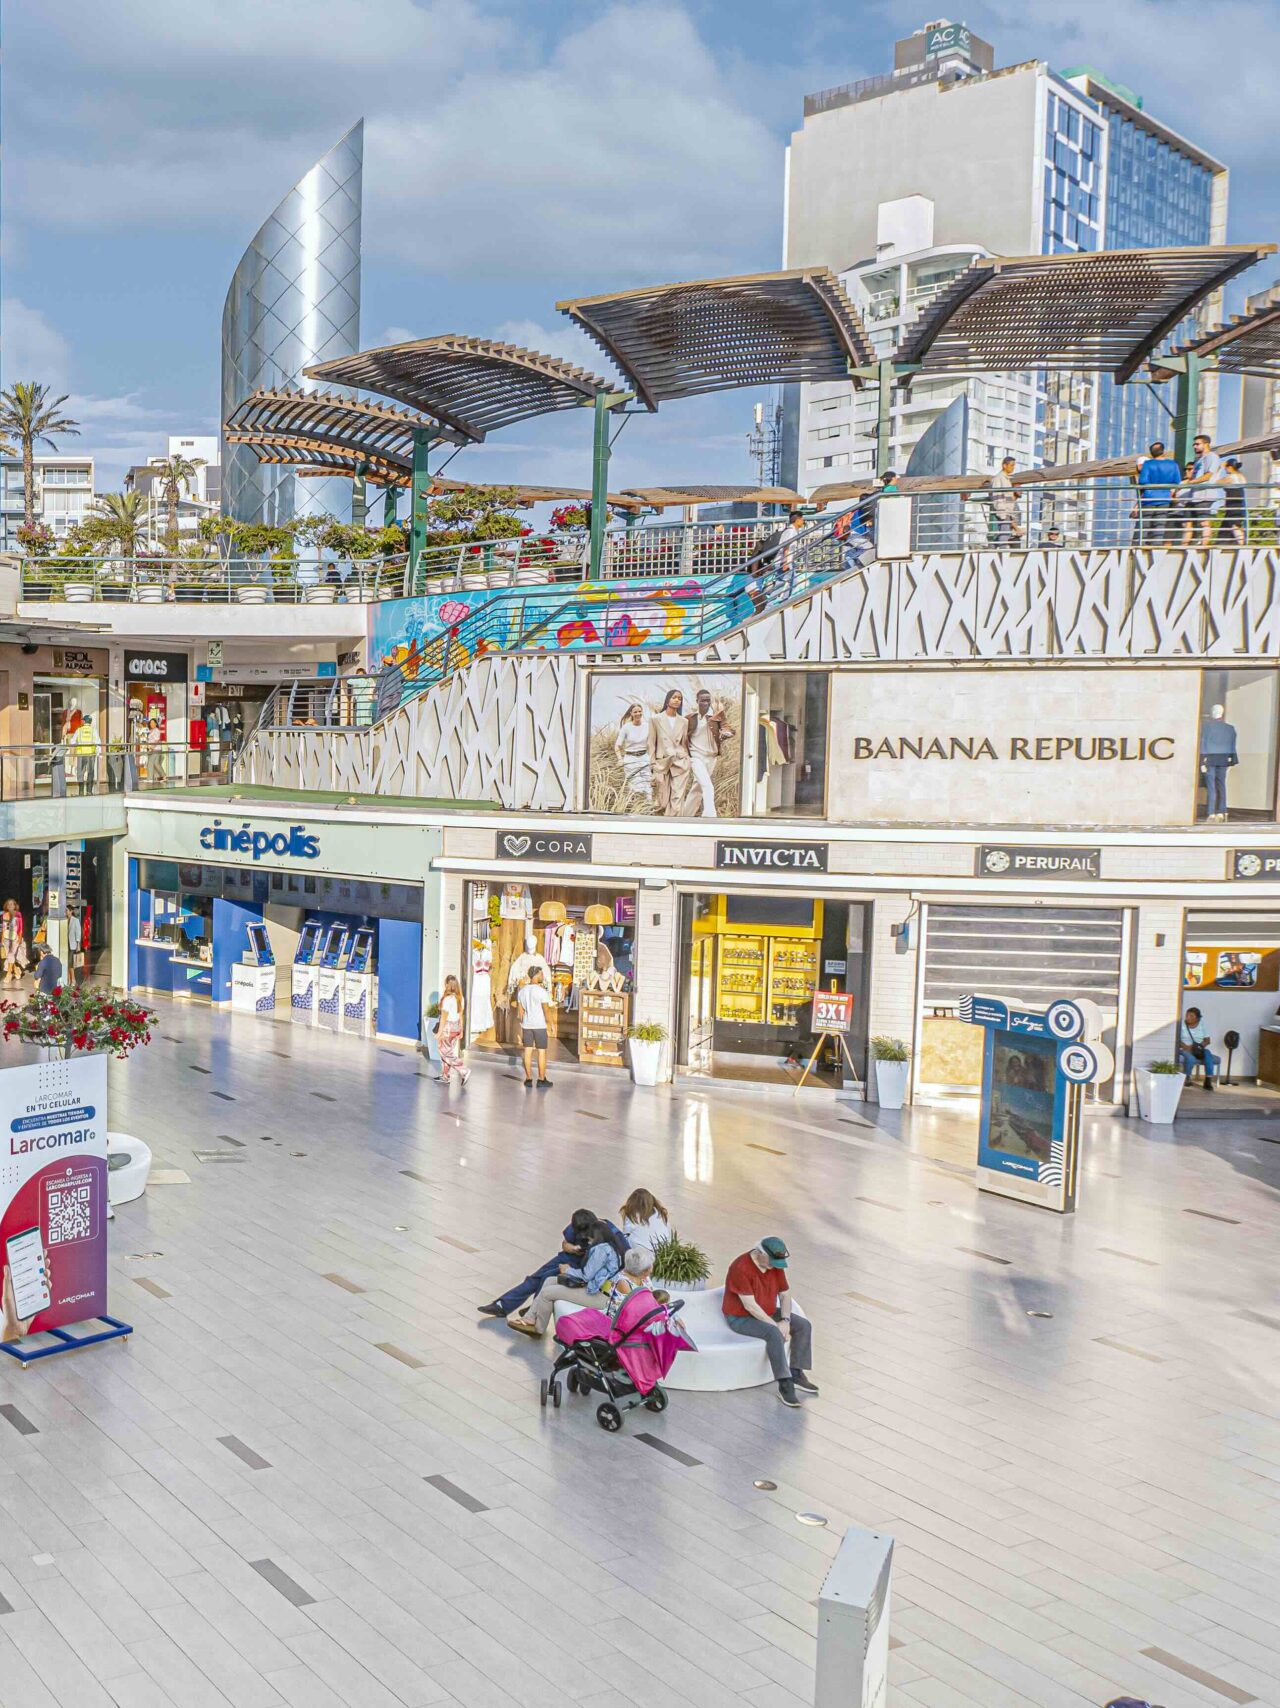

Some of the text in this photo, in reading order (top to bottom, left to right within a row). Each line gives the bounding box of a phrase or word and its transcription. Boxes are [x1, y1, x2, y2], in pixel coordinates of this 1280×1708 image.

[931, 28, 955, 46] AC
[65, 651, 94, 663] SOL
[129, 658, 168, 675] crocs
[228, 685, 245, 697] EXIT
[853, 736, 1176, 761] BANANA REPUBLIC
[200, 819, 320, 860] cinépolis
[535, 840, 587, 854] CORA
[723, 847, 820, 867] INVICTA
[1014, 856, 1096, 871] PERURAIL
[817, 1003, 846, 1020] 3X1
[35, 1090, 73, 1103] LARCOMAR
[26, 1104, 36, 1113] EN
[49, 1097, 81, 1109] CELULAR
[10, 1128, 90, 1155] Larcomar
[58, 1291, 95, 1305] LARCOMAR
